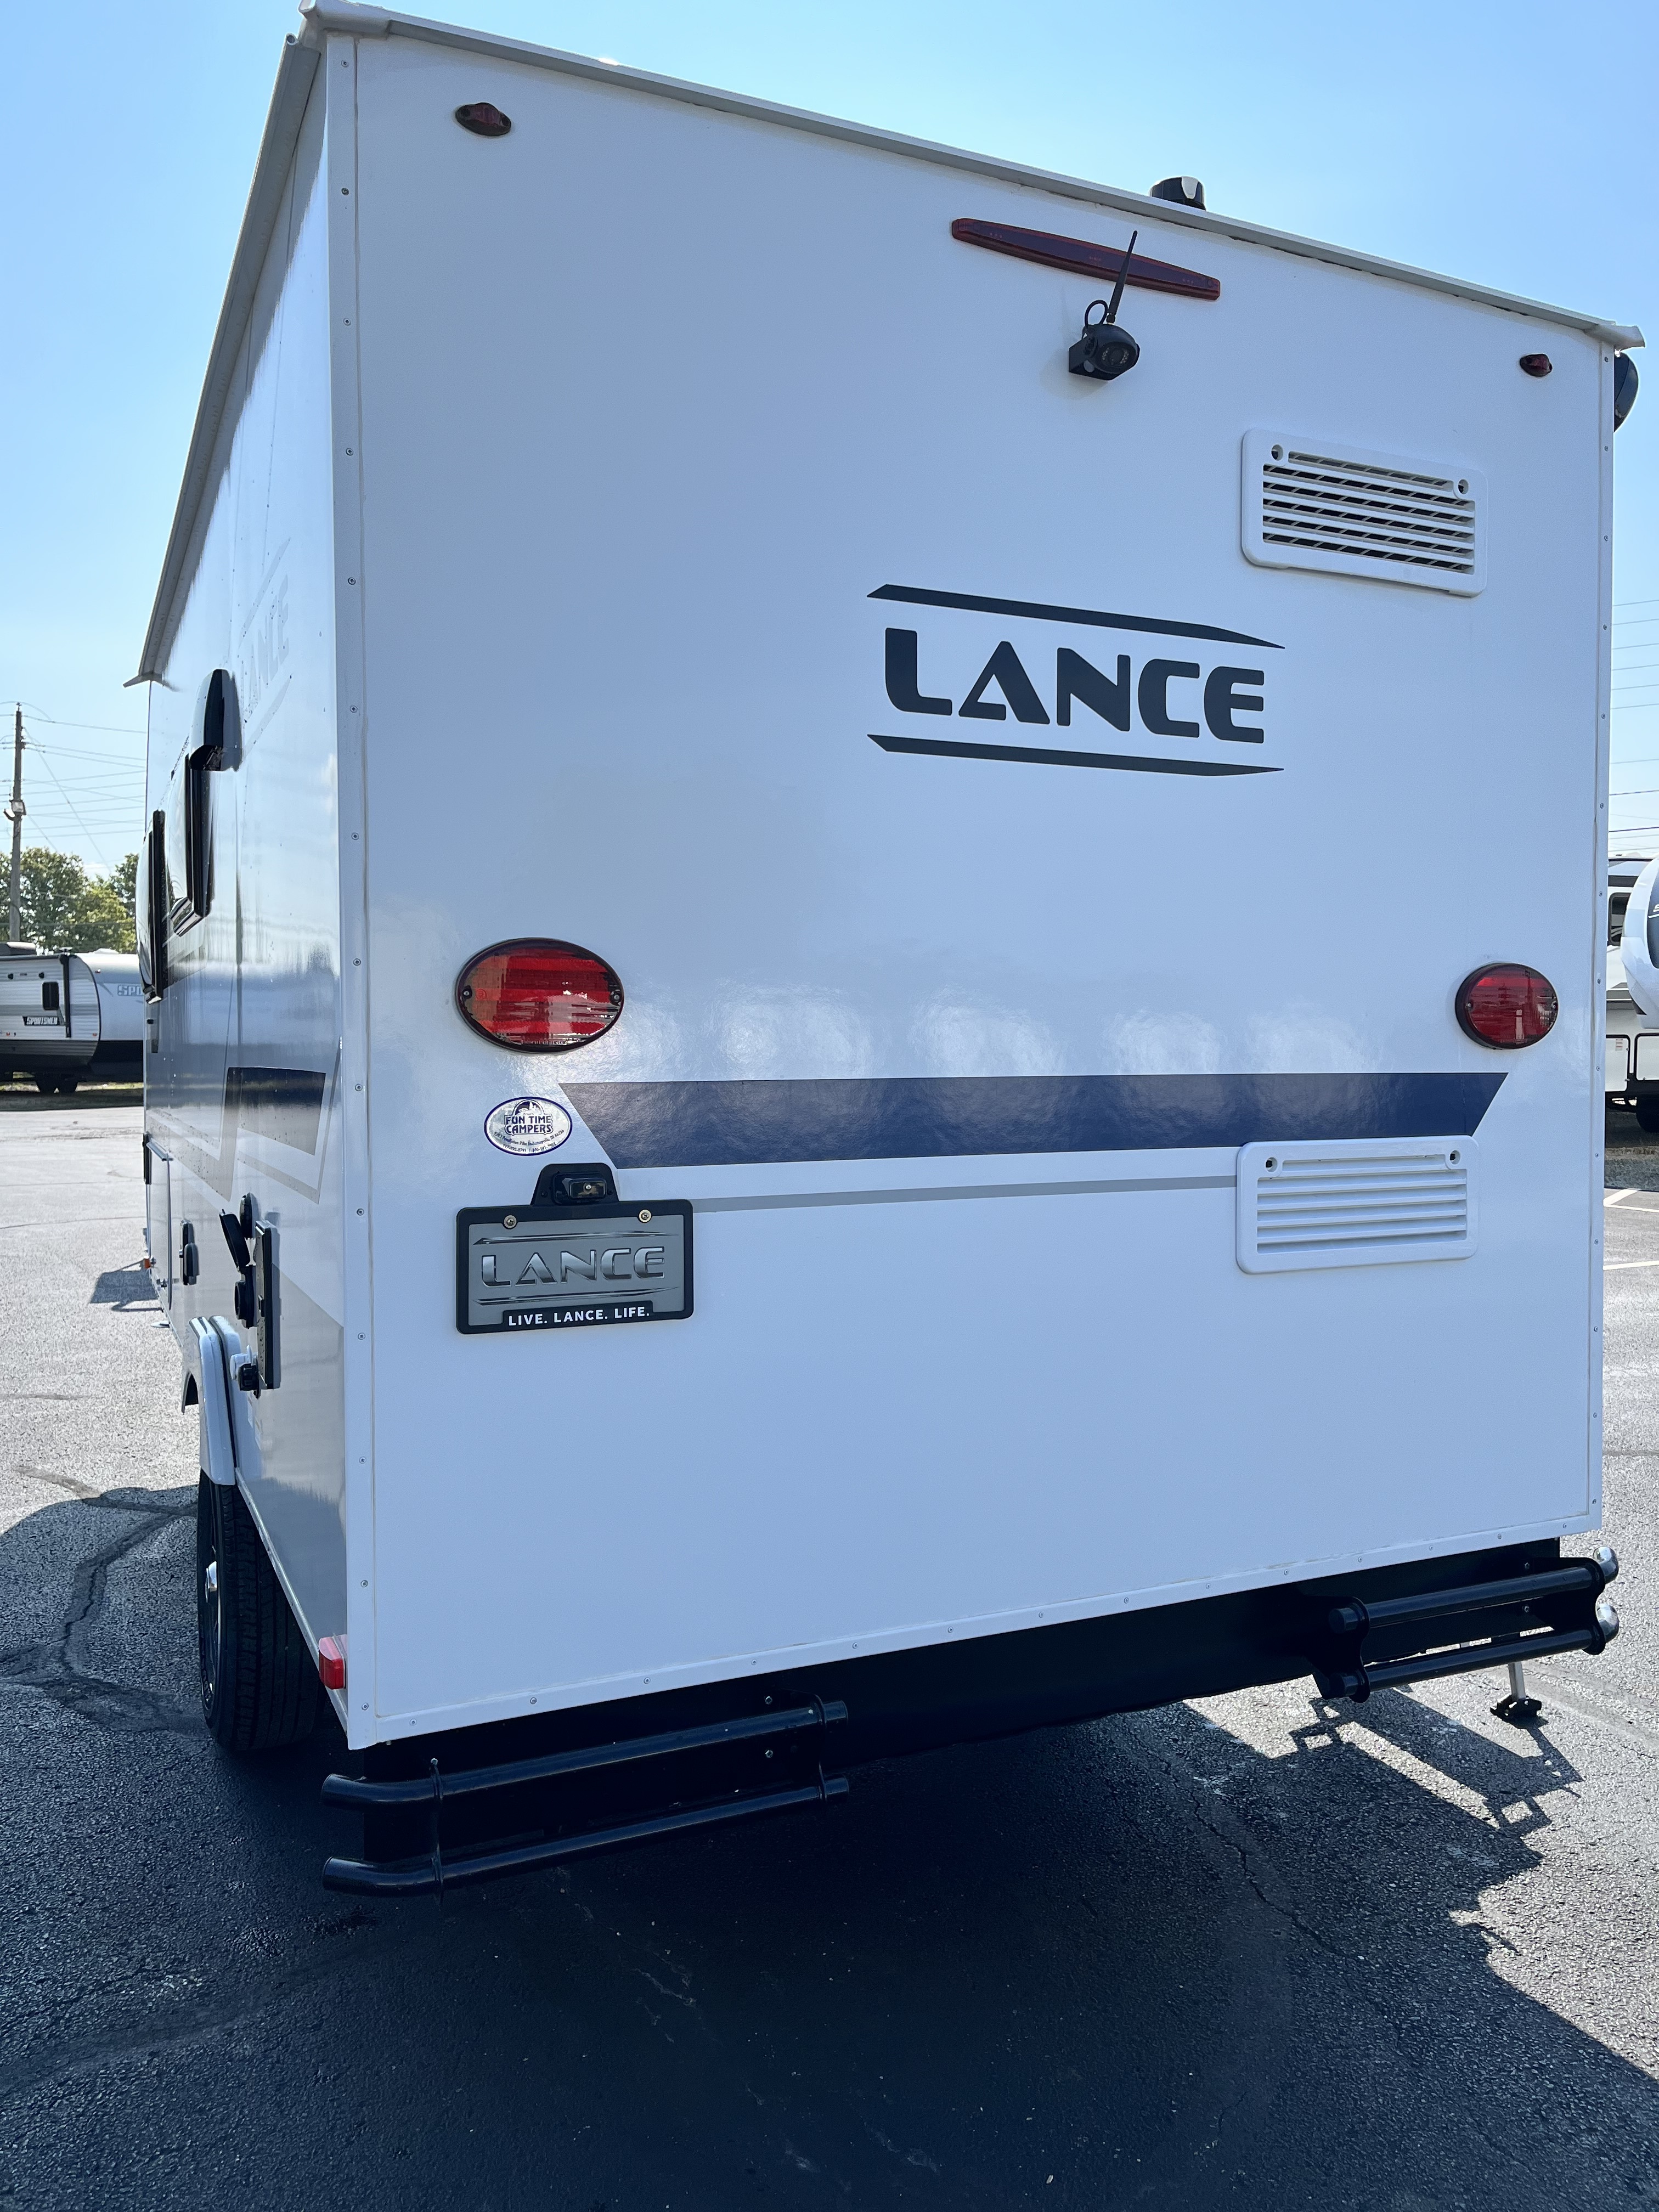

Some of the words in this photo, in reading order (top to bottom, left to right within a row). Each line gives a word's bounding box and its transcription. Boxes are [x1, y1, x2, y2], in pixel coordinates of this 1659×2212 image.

[885, 628, 1265, 744] LANCE
[506, 1116, 525, 1125] FUN
[528, 1115, 551, 1124] TIME
[506, 1124, 551, 1134] CAMPERS
[481, 1246, 665, 1288] LANCE
[509, 1314, 548, 1326] LIVE.
[554, 1309, 608, 1323] LANCE.
[614, 1306, 650, 1318] LIFE.
